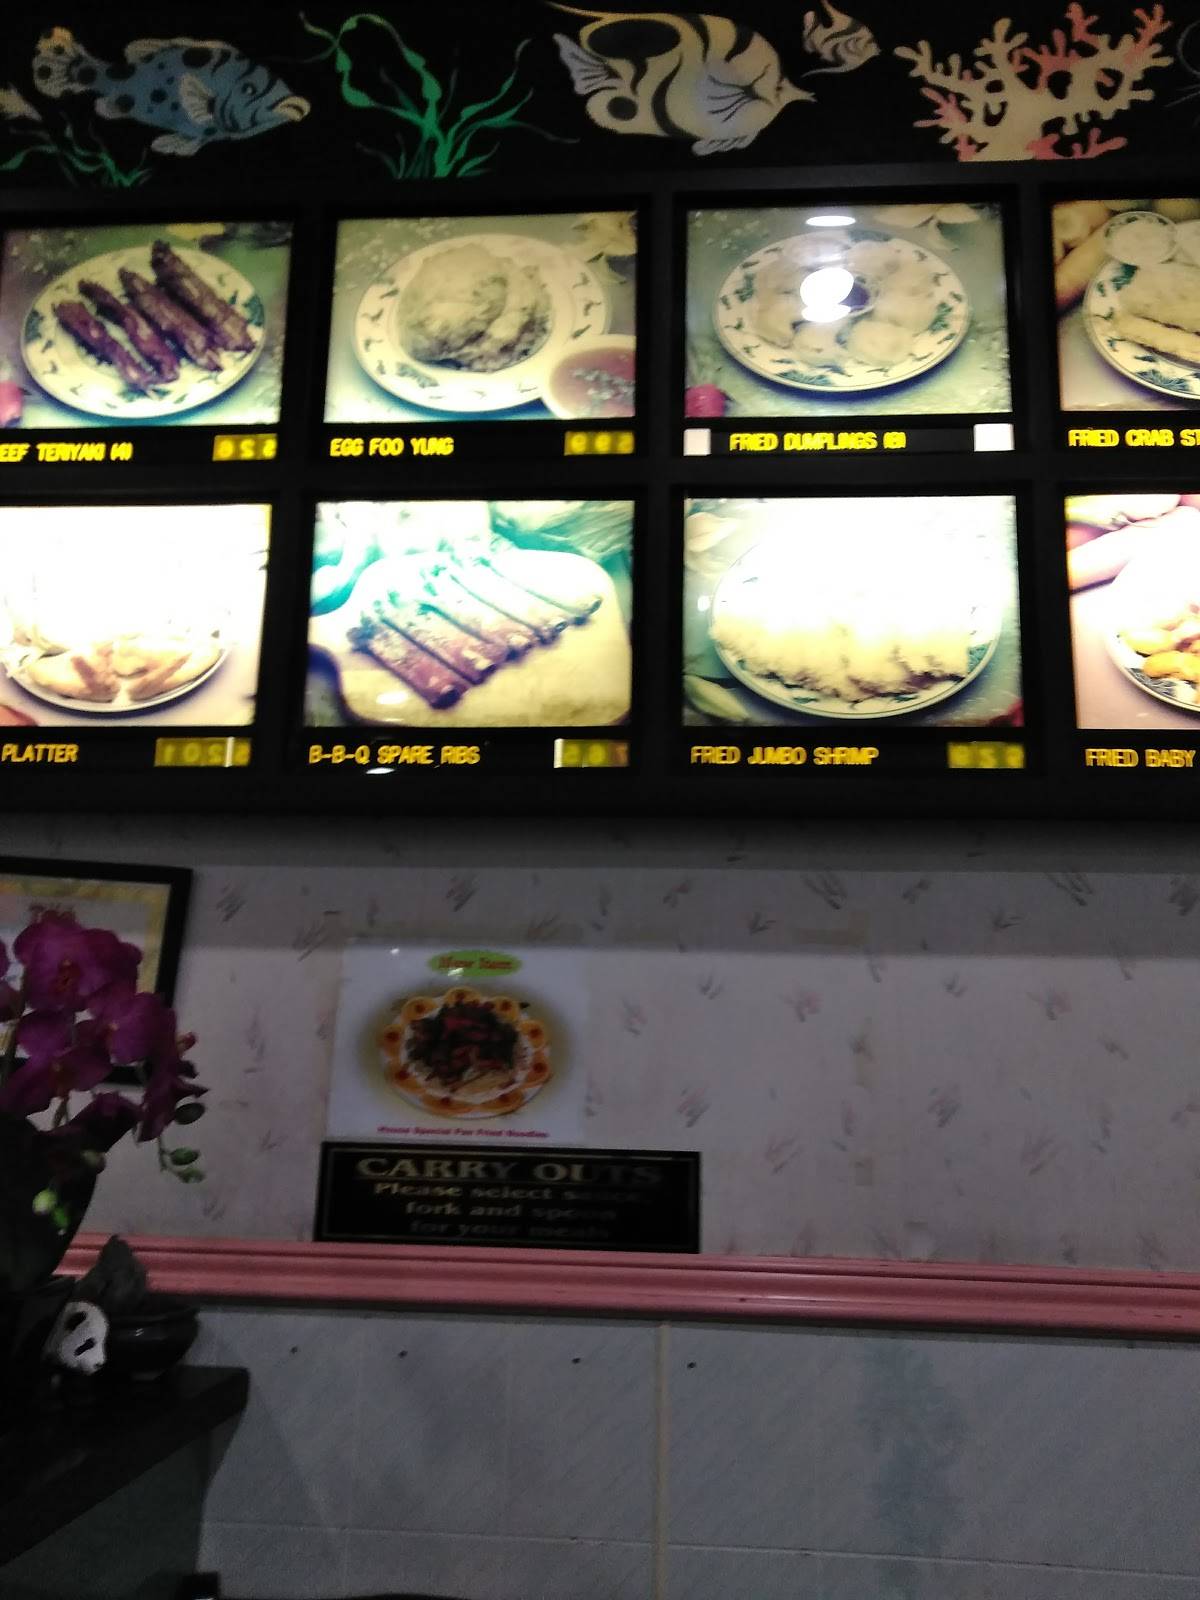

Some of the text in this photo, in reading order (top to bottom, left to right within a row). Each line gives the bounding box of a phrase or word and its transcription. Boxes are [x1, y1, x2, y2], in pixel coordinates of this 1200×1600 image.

[329, 436, 455, 457] EGG FOO YUNG
[729, 432, 779, 452] FRIED
[783, 431, 879, 451] DUMPLINGS
[1067, 429, 1120, 448] FRIED
[1124, 428, 1175, 447] CRAB
[36, 442, 107, 463] TERIYAKI
[1, 743, 79, 764] PLATTER
[308, 744, 481, 765] B-B-Q SPARE RIBS
[690, 745, 879, 766] FRIED JUMBO SHRIMP
[1085, 748, 1196, 768] FRIED BABY
[356, 1157, 520, 1180] CARRY
[373, 1182, 463, 1197] Please
[470, 1186, 553, 1201] select
[404, 1200, 462, 1215] fork
[468, 1203, 522, 1217] and
